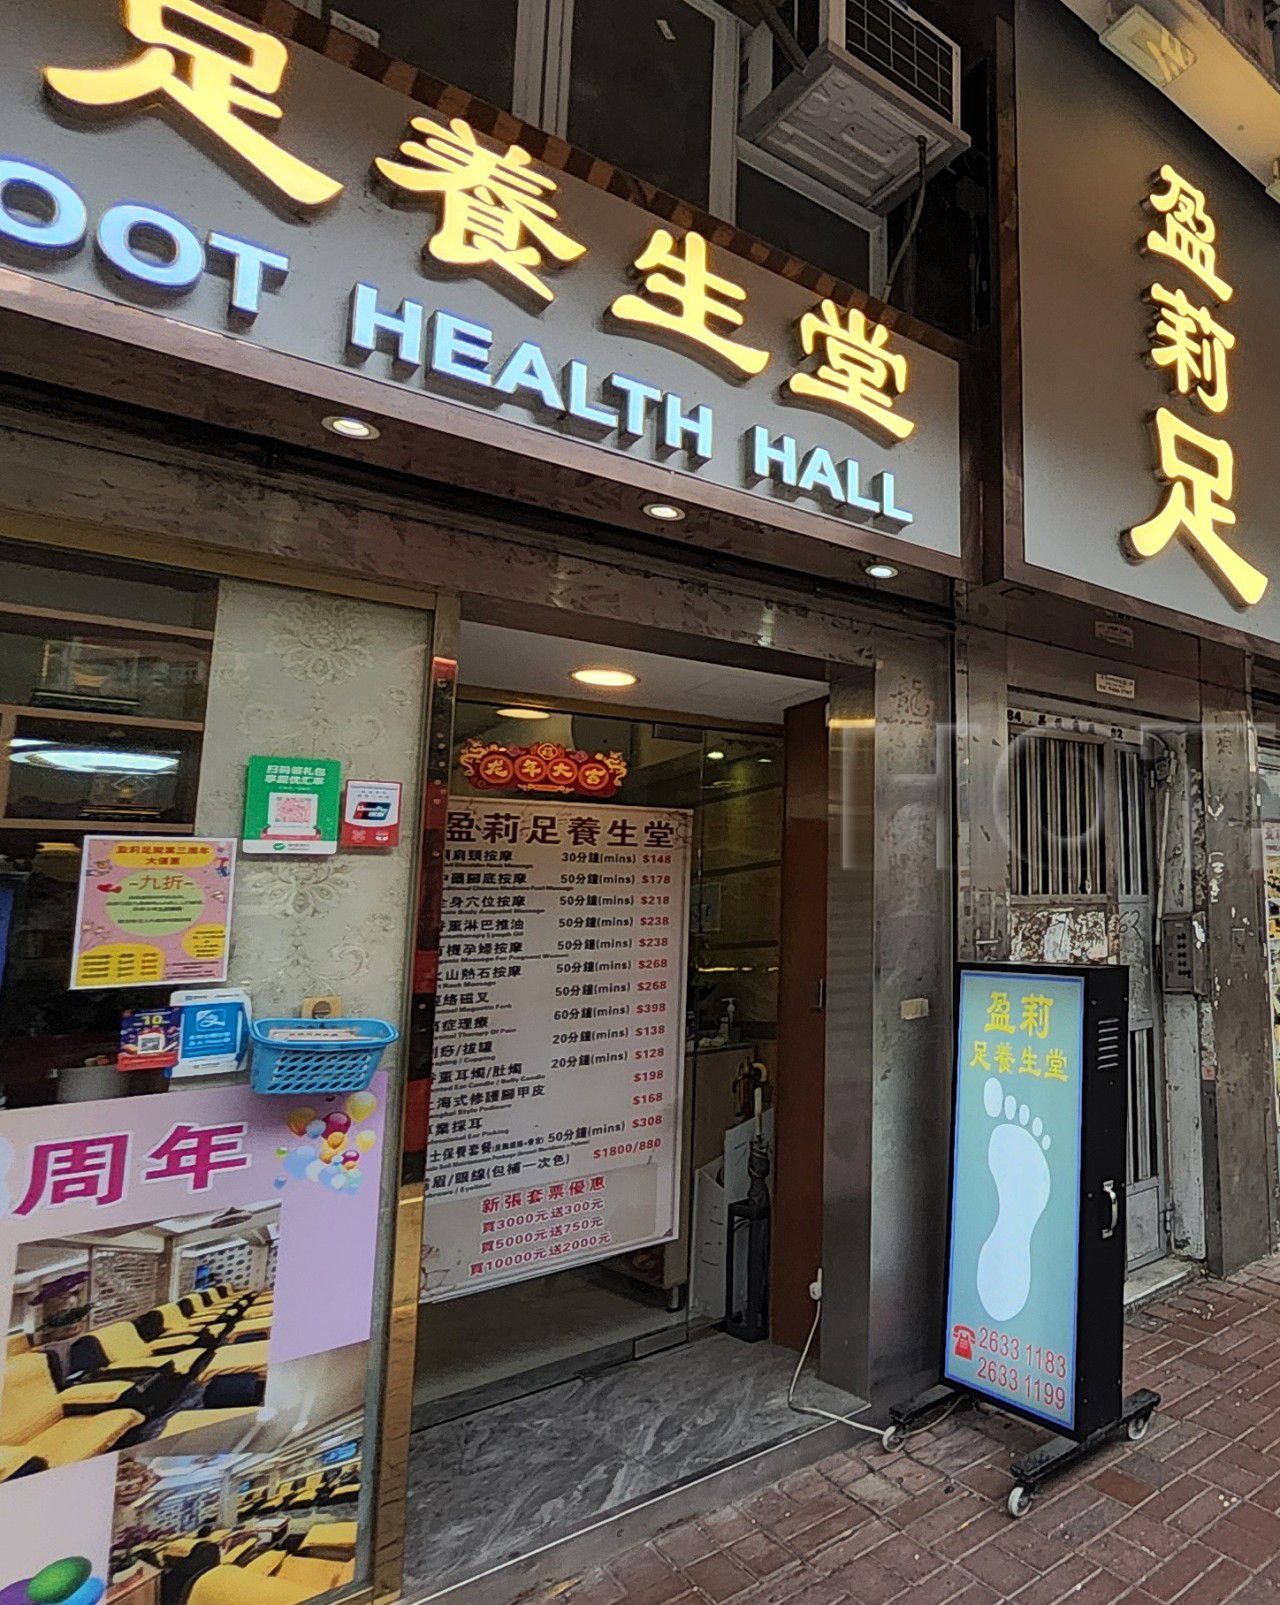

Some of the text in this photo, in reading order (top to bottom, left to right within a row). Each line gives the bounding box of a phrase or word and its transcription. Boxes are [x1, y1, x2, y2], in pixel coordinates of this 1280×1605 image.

[1131, 163, 1269, 605] 盈莉足
[350, 282, 713, 460] HEALTH
[754, 425, 914, 525] HALL
[446, 811, 675, 849] 盈莉足養生堂
[642, 854, 672, 865] $148
[641, 875, 671, 885] $178
[640, 895, 670, 906] $218
[639, 916, 670, 928] $238
[638, 937, 669, 949] $238
[638, 959, 668, 970] $268
[637, 980, 667, 992] $268
[636, 1002, 666, 1015] $398
[984, 991, 1054, 1039] 盈莉
[635, 1024, 665, 1037] $138
[634, 1047, 665, 1059] $128
[969, 1041, 1069, 1082] 足養生堂
[633, 1069, 664, 1083] $198
[632, 1092, 663, 1105] $168
[632, 1115, 662, 1129] $308
[12, 1124, 249, 1216] 周年
[481, 1176, 606, 1214] 新張套票優惠
[978, 1327, 1066, 1379] 2633 1183
[977, 1357, 1066, 1411] 2633 1199
